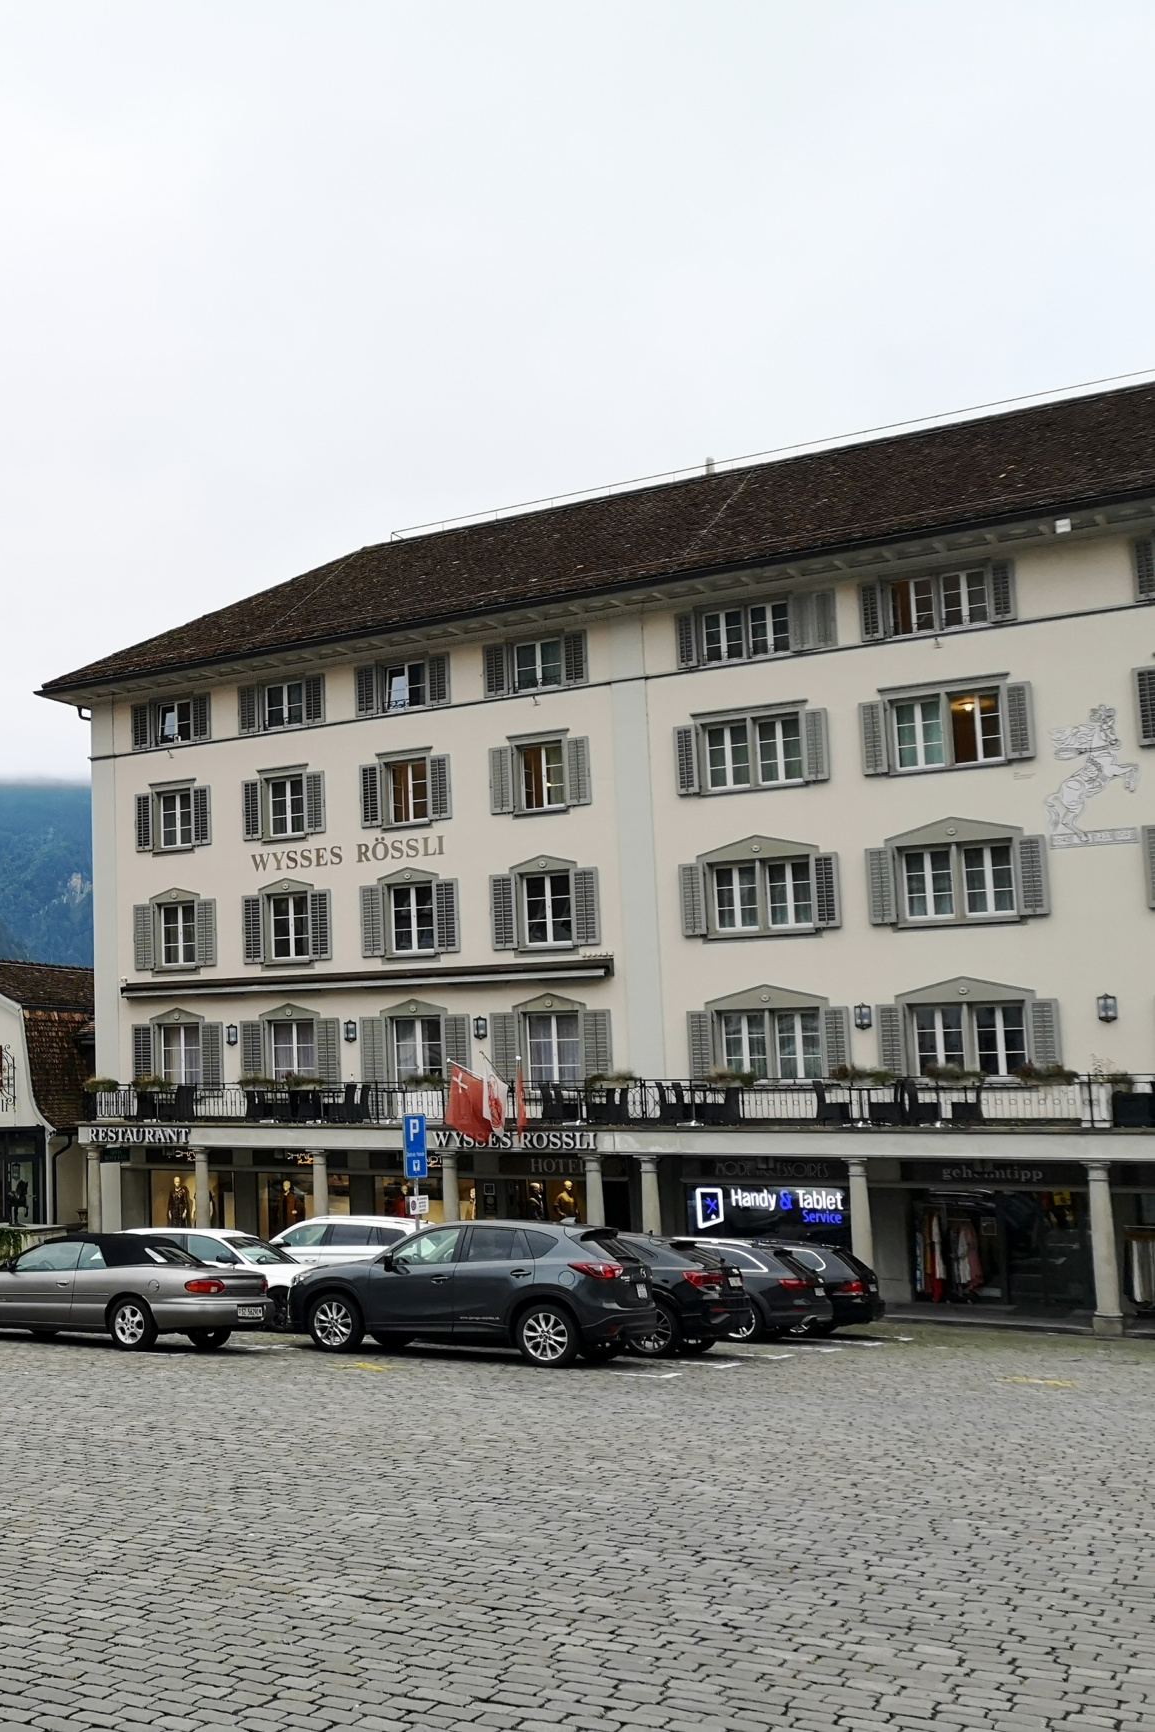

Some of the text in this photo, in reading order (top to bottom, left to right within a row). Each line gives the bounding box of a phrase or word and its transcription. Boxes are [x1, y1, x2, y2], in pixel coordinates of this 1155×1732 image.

[251, 835, 445, 872] WYSSES RÖSSLI
[89, 1128, 189, 1143] RESTAURANT
[409, 1119, 420, 1141] P
[731, 1188, 844, 1211] Handy & Tablet
[803, 1210, 842, 1224] Service
